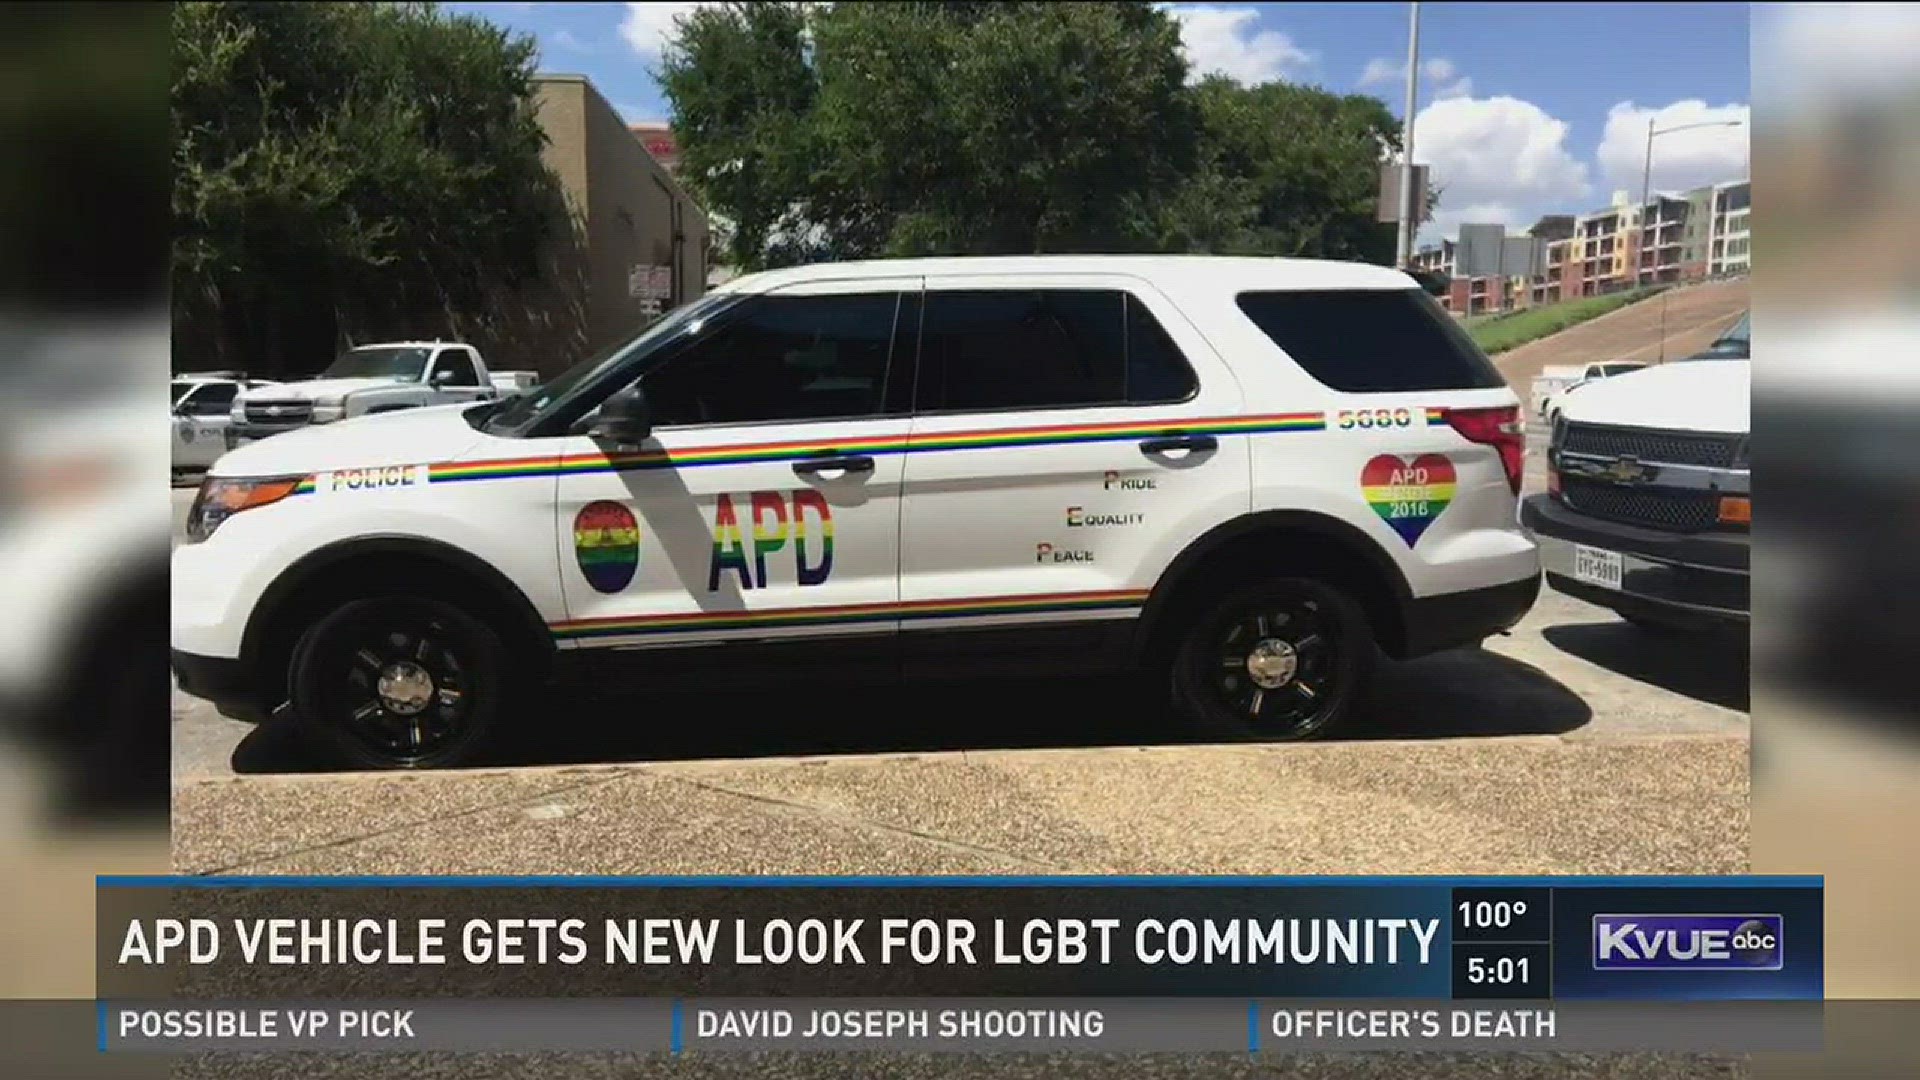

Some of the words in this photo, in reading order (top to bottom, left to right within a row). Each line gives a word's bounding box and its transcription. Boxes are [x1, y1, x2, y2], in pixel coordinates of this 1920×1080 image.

[332, 464, 416, 491] POLICE
[1104, 469, 1157, 490] PRIDE
[1390, 467, 1430, 485] APD
[1391, 500, 1429, 518] 2016
[709, 489, 833, 592] APD
[1037, 543, 1094, 562] PEACE
